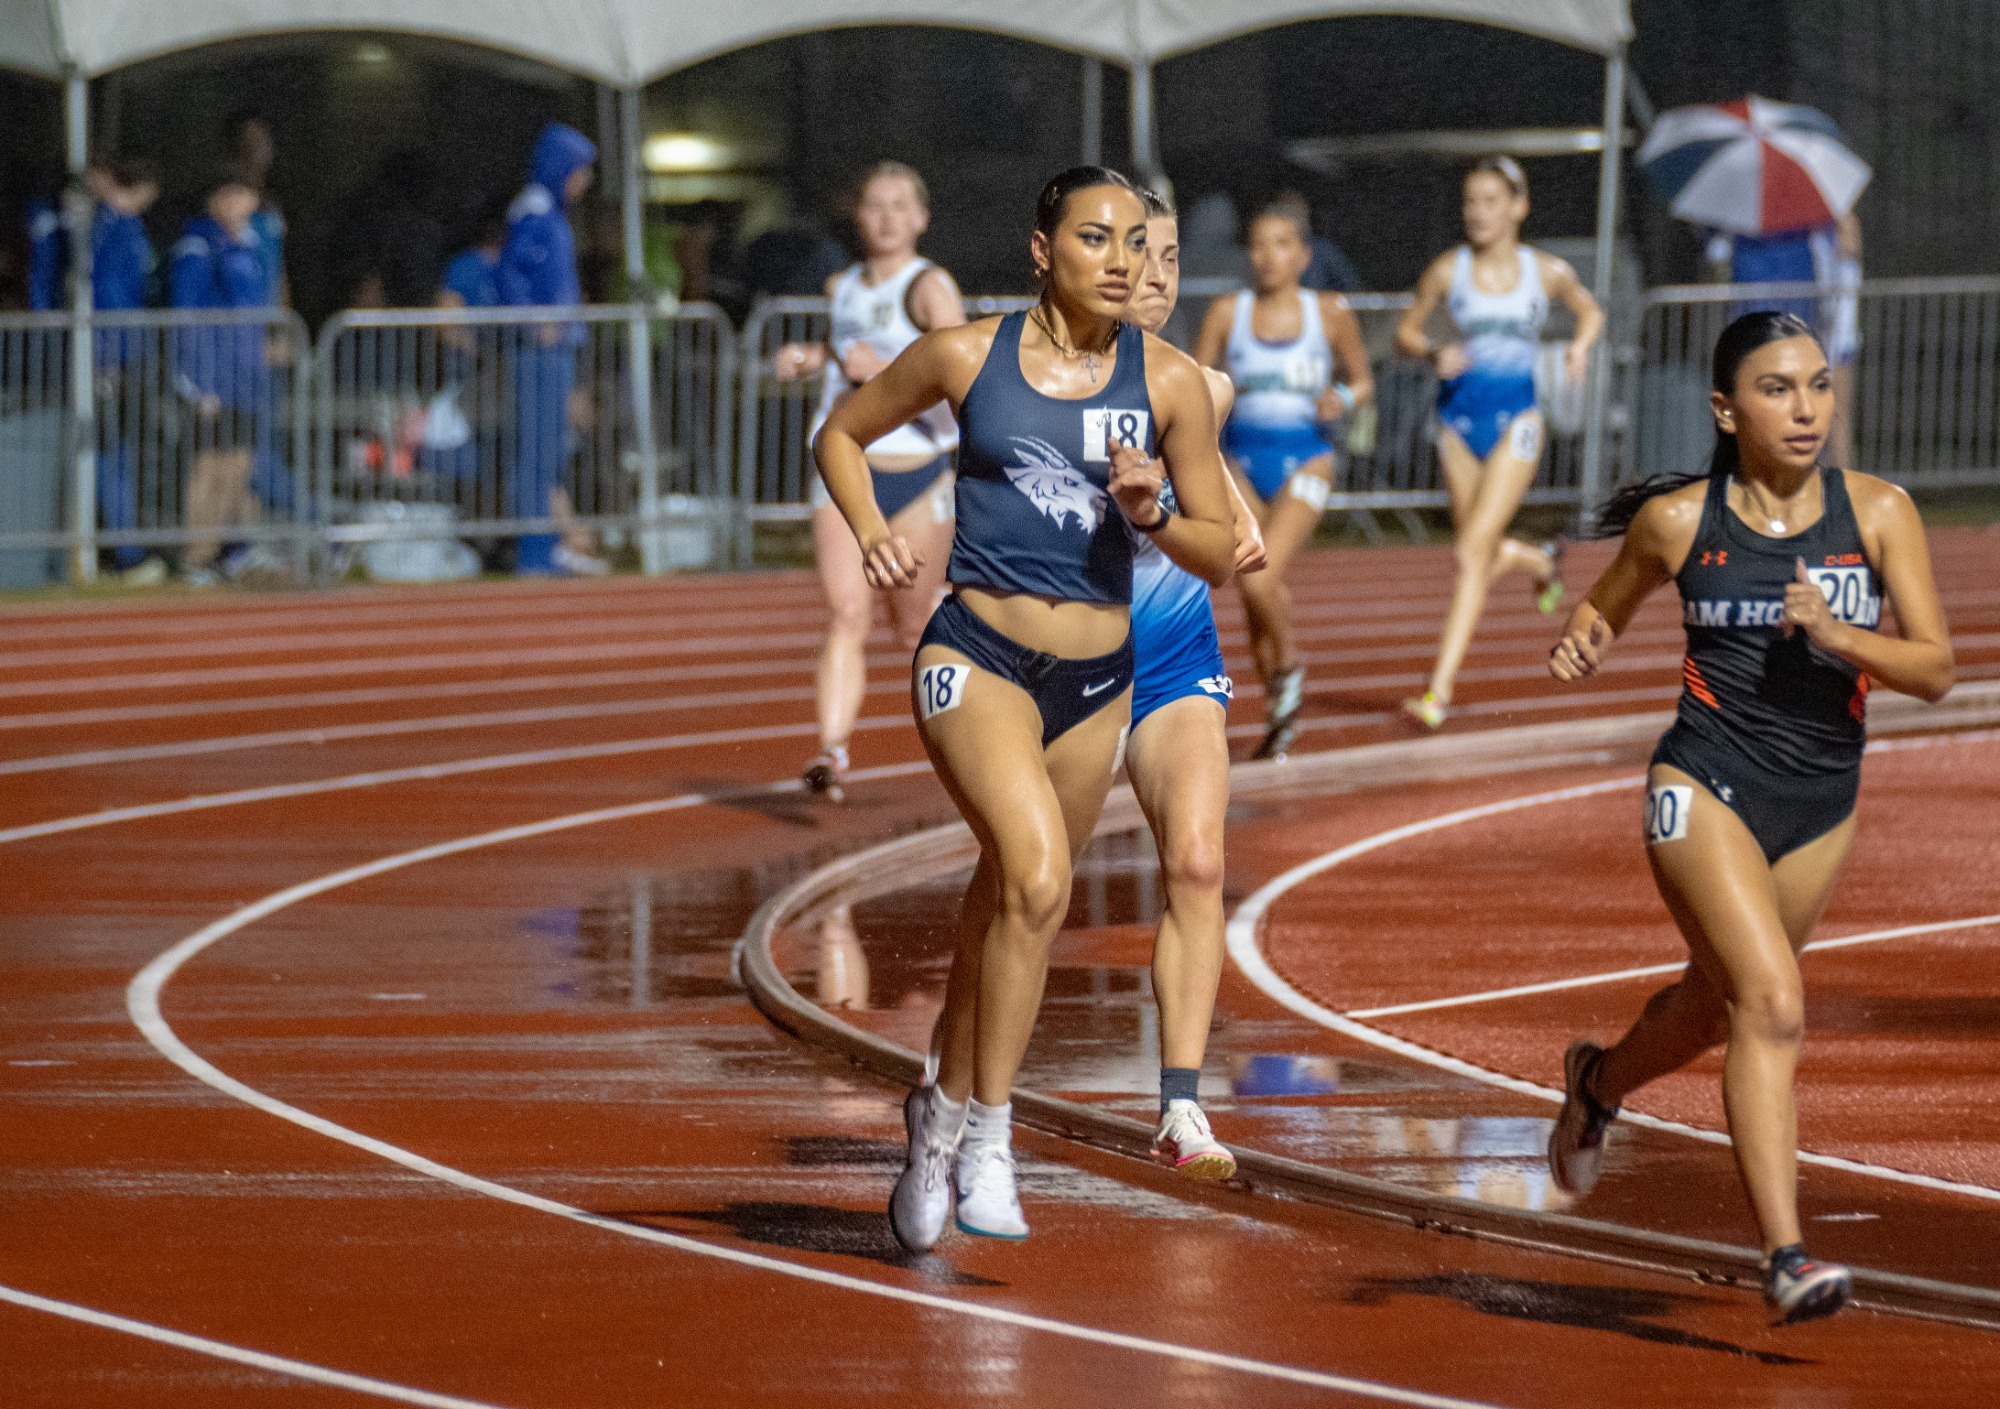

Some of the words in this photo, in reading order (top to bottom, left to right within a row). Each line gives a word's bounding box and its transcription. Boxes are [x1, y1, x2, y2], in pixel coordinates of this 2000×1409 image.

[1103, 411, 1138, 457] 18
[1684, 600, 1731, 627] AM
[1819, 572, 1860, 621] 20
[923, 666, 956, 714] 18
